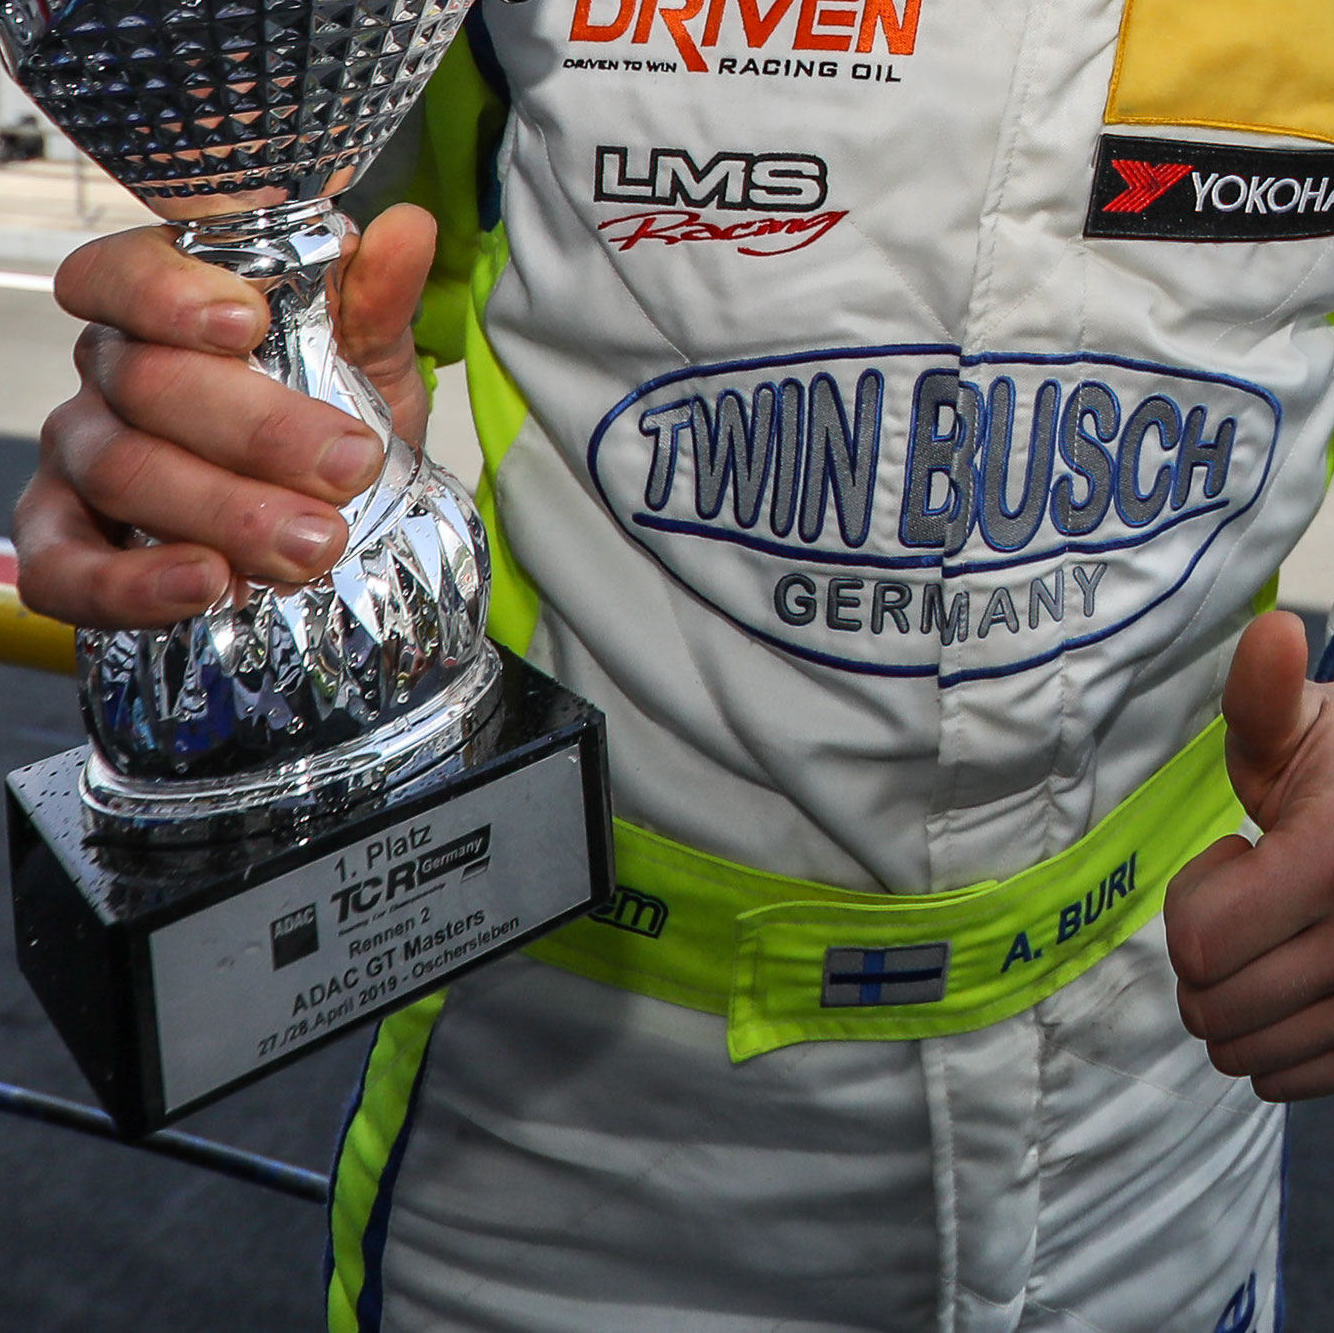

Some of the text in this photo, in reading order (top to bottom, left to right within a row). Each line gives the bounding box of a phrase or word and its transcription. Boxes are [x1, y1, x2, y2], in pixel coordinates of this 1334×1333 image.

[562, 57, 677, 73] DRIVEN TO WIN
[718, 57, 902, 83] RACING OIL
[594, 145, 828, 212] LMS
[638, 368, 1236, 557] TWIN BUSCH
[773, 561, 1107, 647] GERMANY
[330, 860, 419, 924] TCR
[421, 836, 484, 874] Germany
[334, 825, 432, 883] 1. Platz
[273, 906, 316, 939] ADAC
[349, 917, 415, 960] Rennen
[420, 906, 432, 925] 2
[1001, 850, 1137, 974] A. BURI
[291, 967, 359, 1018] ADAC
[366, 947, 397, 979] GT
[403, 909, 485, 962] Masters
[359, 975, 398, 1007] 2019
[412, 917, 519, 978] Oschersleben
